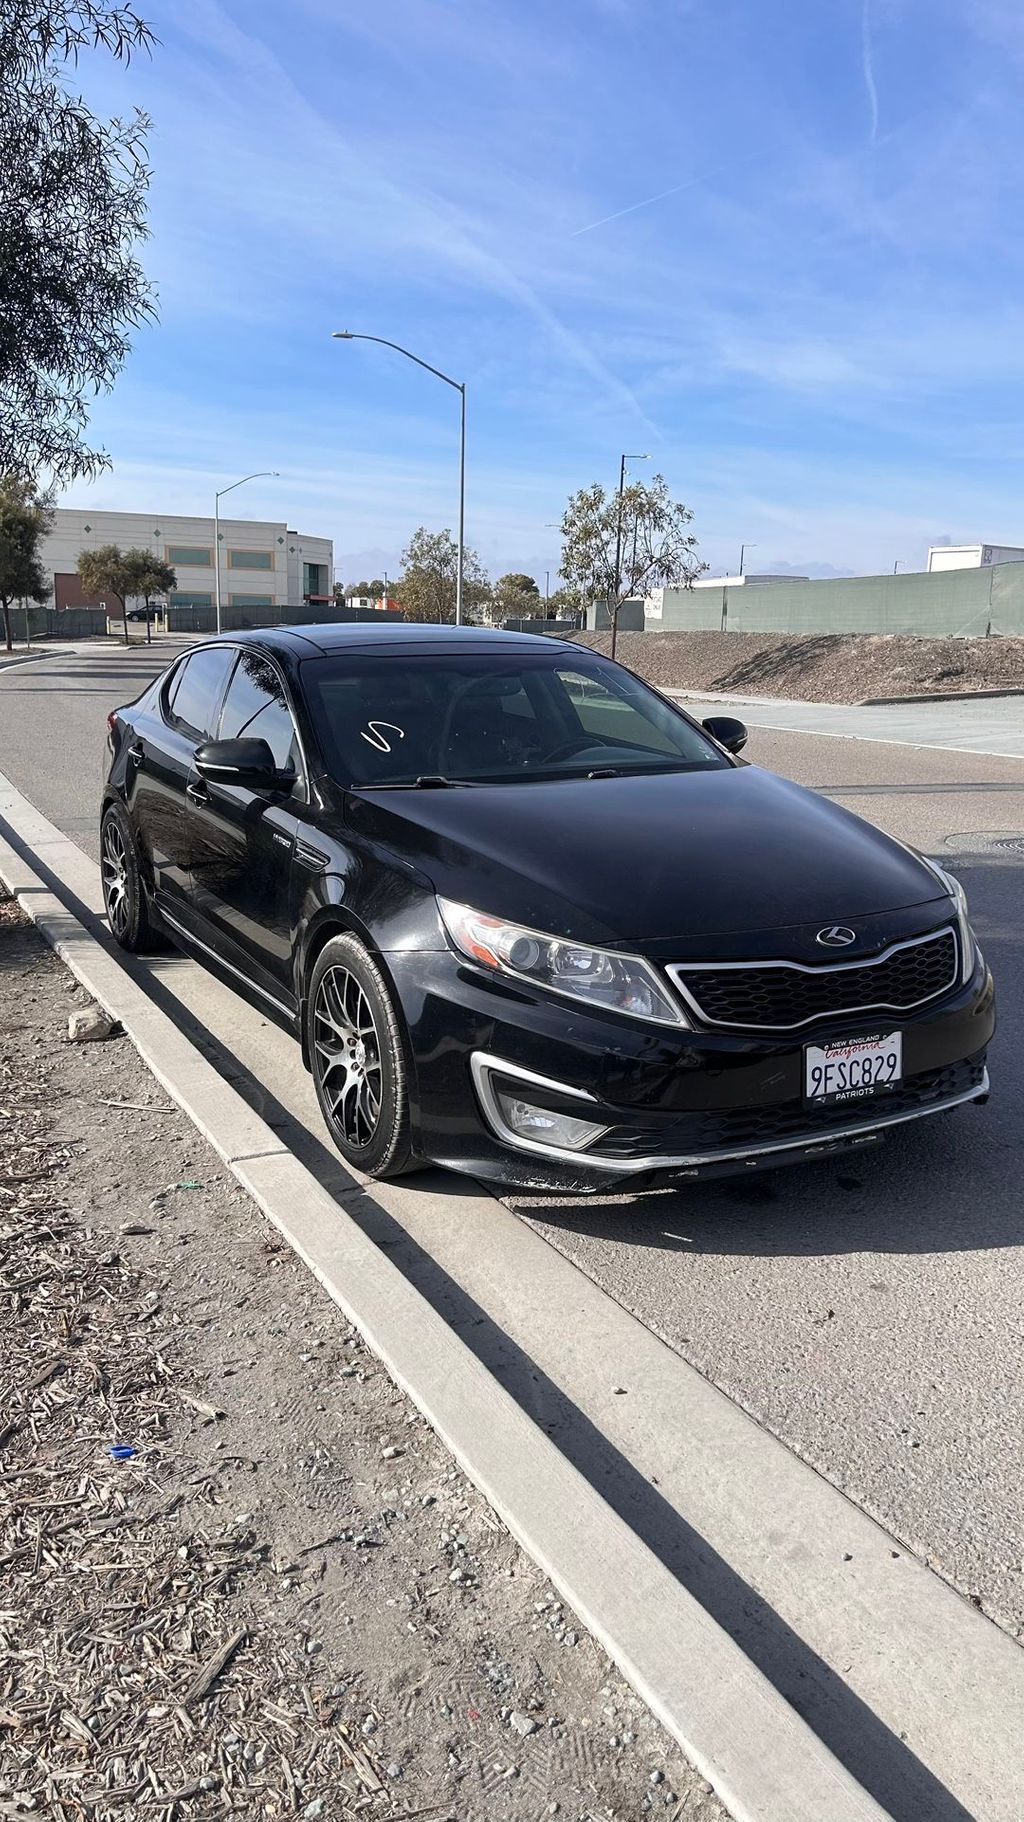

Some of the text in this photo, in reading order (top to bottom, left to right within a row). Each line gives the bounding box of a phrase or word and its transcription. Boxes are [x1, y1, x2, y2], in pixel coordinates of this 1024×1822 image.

[831, 1034, 880, 1049] NEW ENGLAND
[825, 1041, 885, 1059] California
[811, 1053, 897, 1096] 9FSC829
[835, 1087, 875, 1101] PATRIOTS
